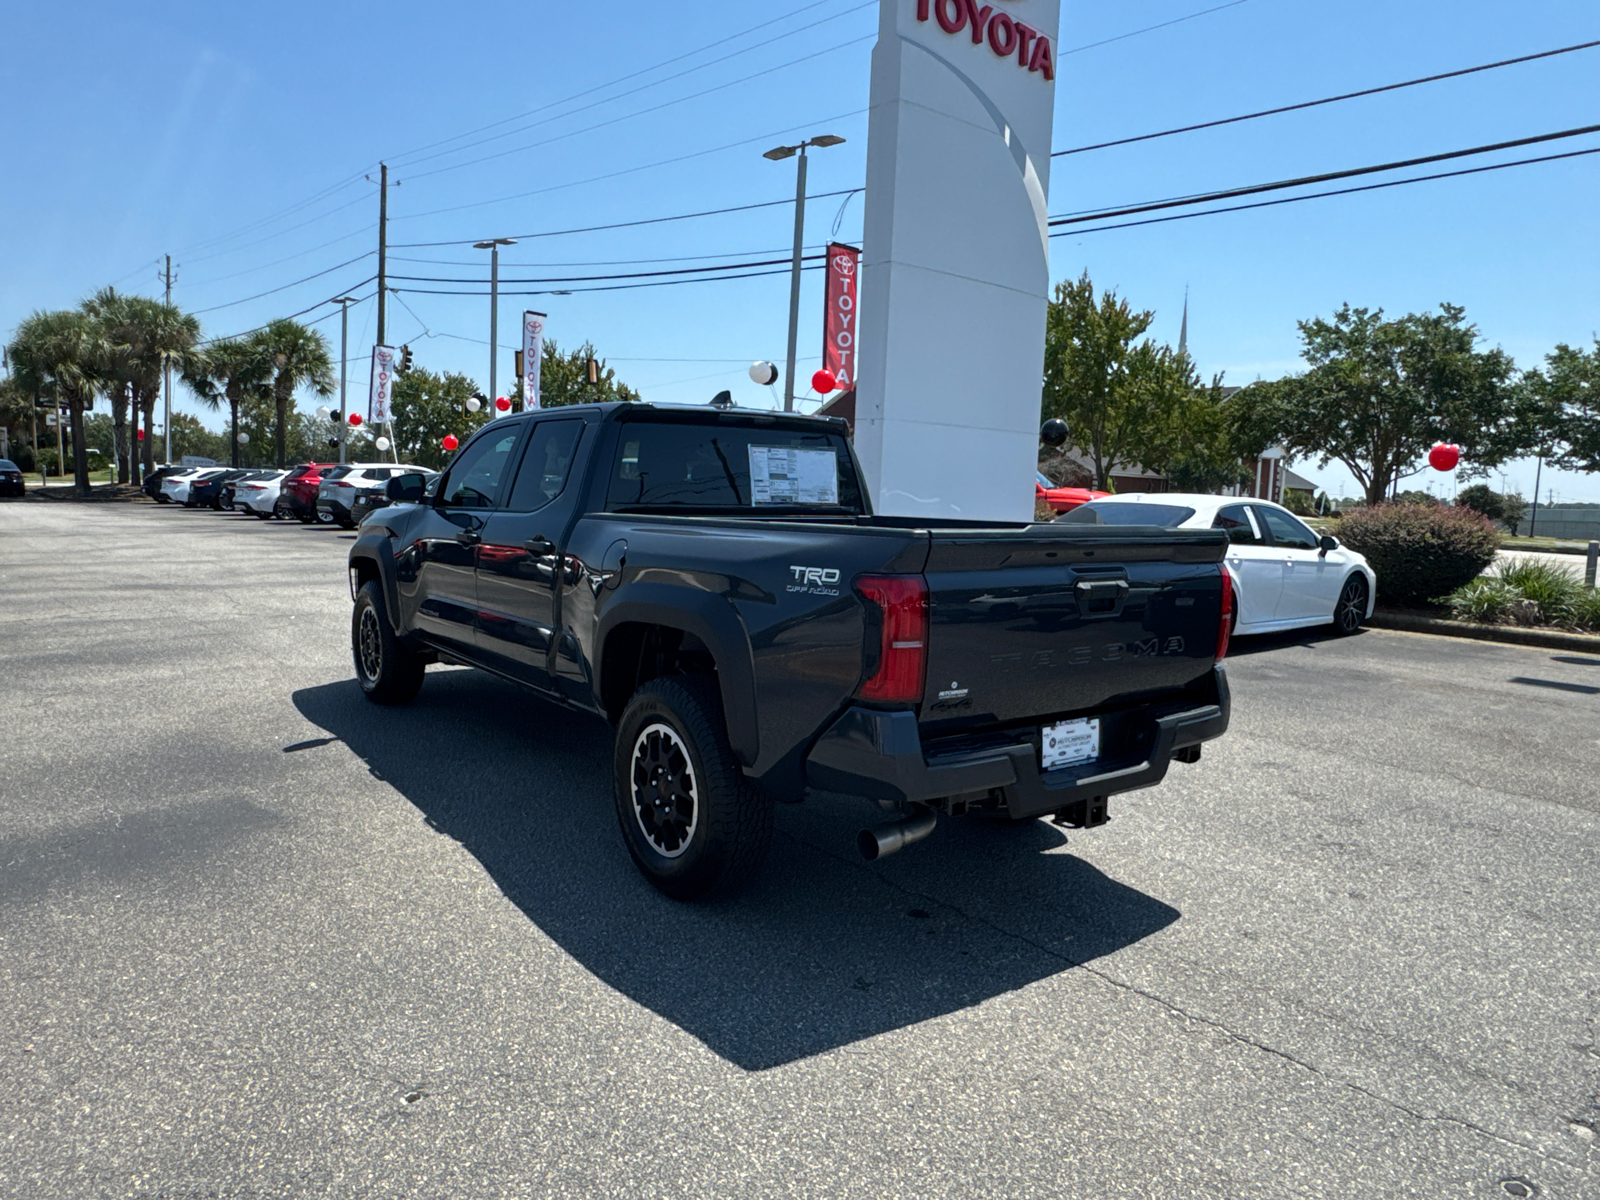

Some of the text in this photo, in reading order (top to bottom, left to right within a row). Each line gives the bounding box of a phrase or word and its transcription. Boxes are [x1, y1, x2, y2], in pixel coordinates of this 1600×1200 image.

[836, 278, 853, 384] TOYOTA
[376, 363, 388, 418] TOYOTA
[527, 336, 537, 407] TOYOTA
[790, 565, 840, 585] TRD
[808, 586, 840, 596] ROAD
[990, 636, 1185, 671] TACOMA
